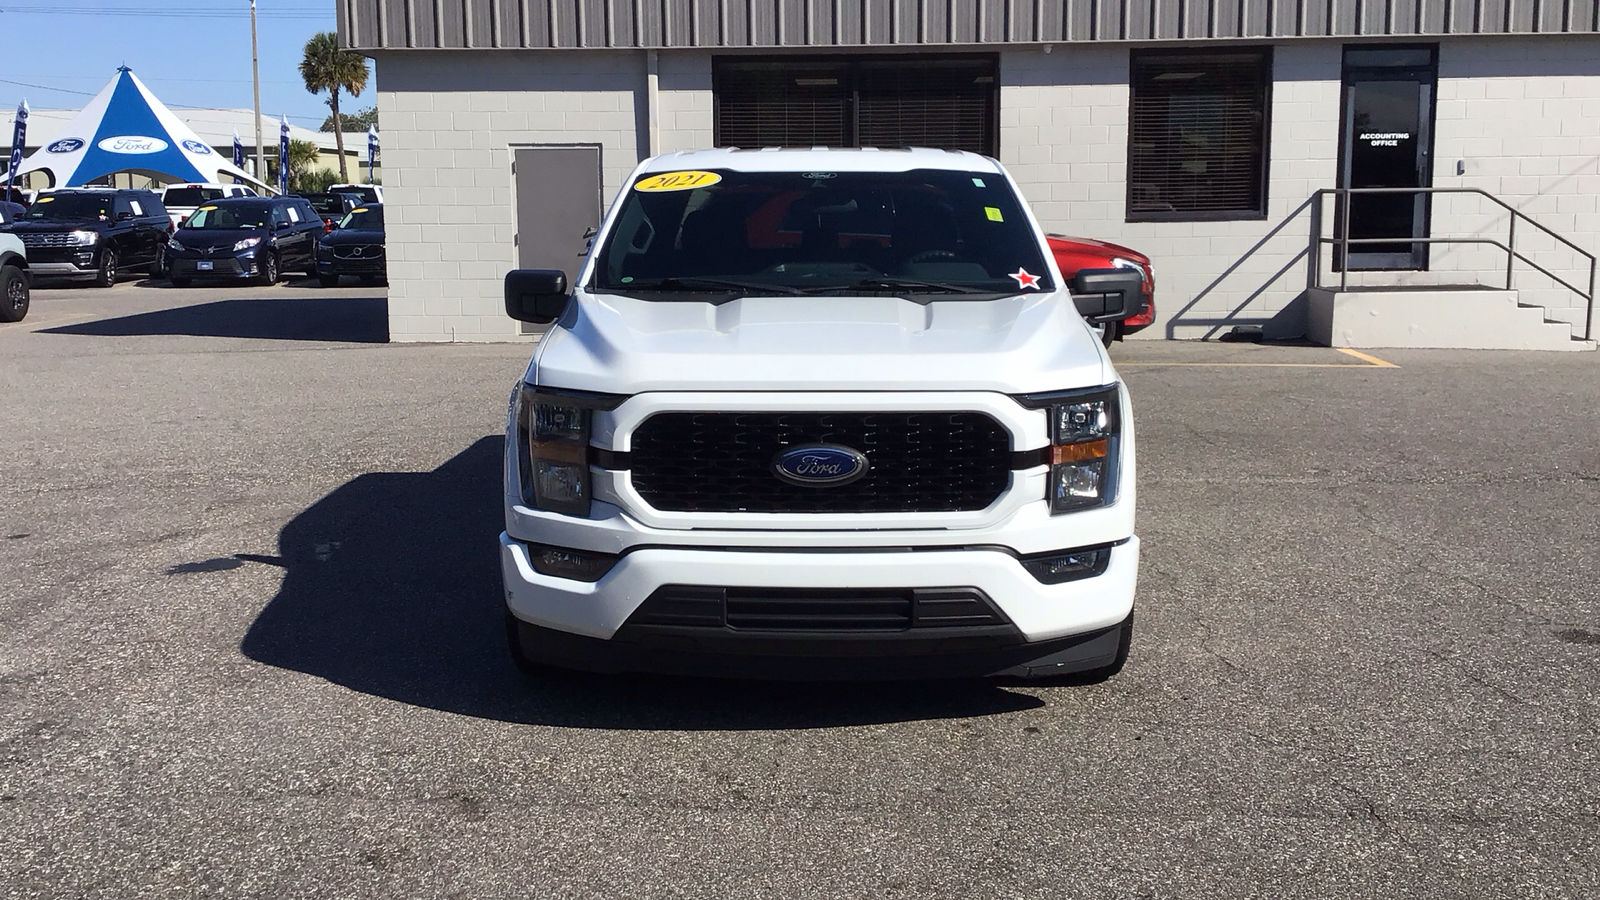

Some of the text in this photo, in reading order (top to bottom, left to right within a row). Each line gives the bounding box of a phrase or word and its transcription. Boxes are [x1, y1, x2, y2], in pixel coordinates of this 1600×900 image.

[1359, 132, 1410, 140] ACCOUNTING
[51, 140, 80, 152] Ford
[113, 139, 153, 150] Ford
[186, 140, 208, 154] Ford
[646, 173, 707, 189] 2021
[796, 455, 841, 474] Ford
